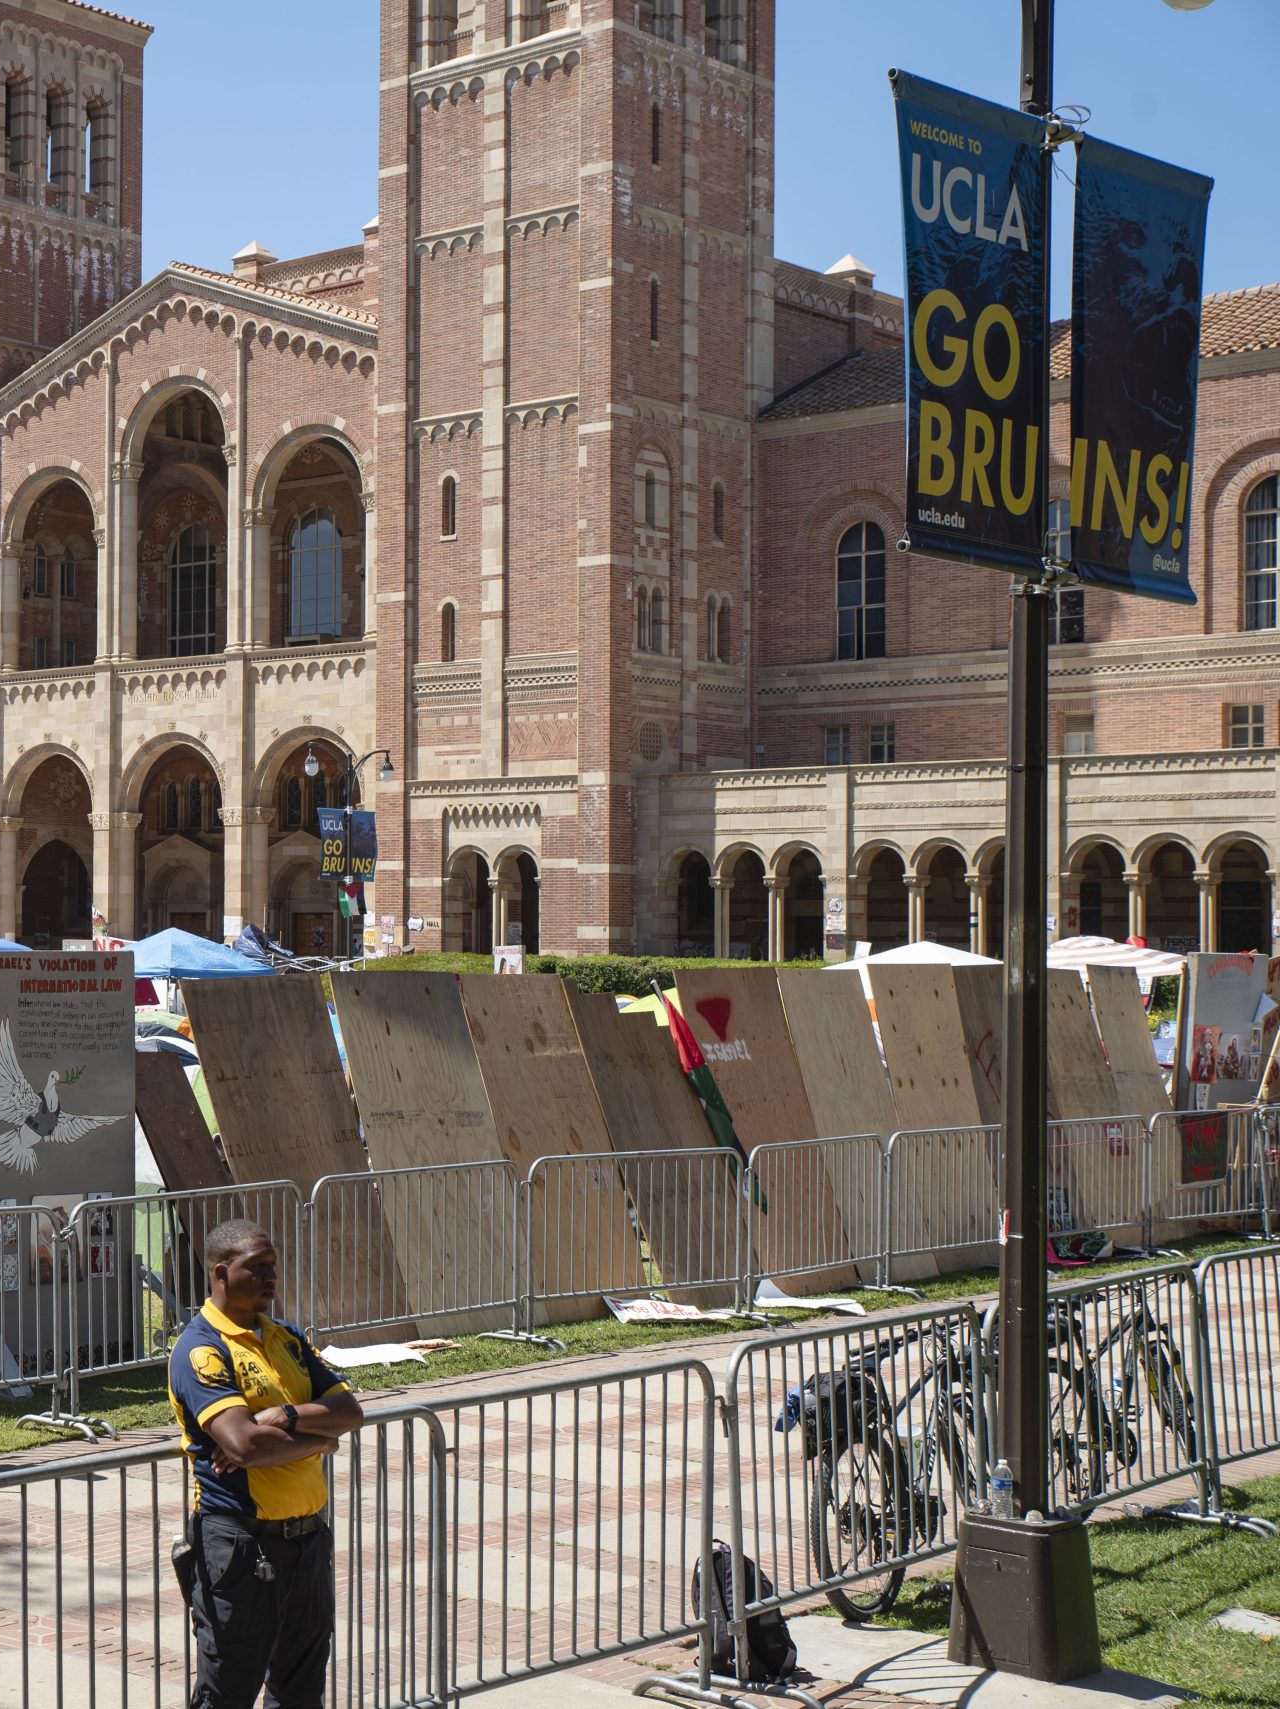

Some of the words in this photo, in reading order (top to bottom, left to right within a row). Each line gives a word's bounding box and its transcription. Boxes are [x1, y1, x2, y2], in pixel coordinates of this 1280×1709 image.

[910, 119, 964, 150] WELCOME
[968, 138, 982, 155] TO
[911, 152, 1029, 252] UCLA
[913, 288, 1020, 400] GO
[917, 399, 1039, 516] BRU
[918, 507, 965, 529] ucla.edu
[1152, 553, 1181, 574] @ucla
[322, 820, 343, 831] UCLA
[324, 839, 343, 855] GO
[322, 857, 346, 873] BRU
[38, 958, 96, 973] VIOLATION
[103, 957, 118, 971] OF
[20, 979, 99, 993] INTERNATIONAL
[101, 979, 122, 992] LAW
[244, 1375, 269, 1388] STAFF
[257, 1385, 268, 1398] 01
